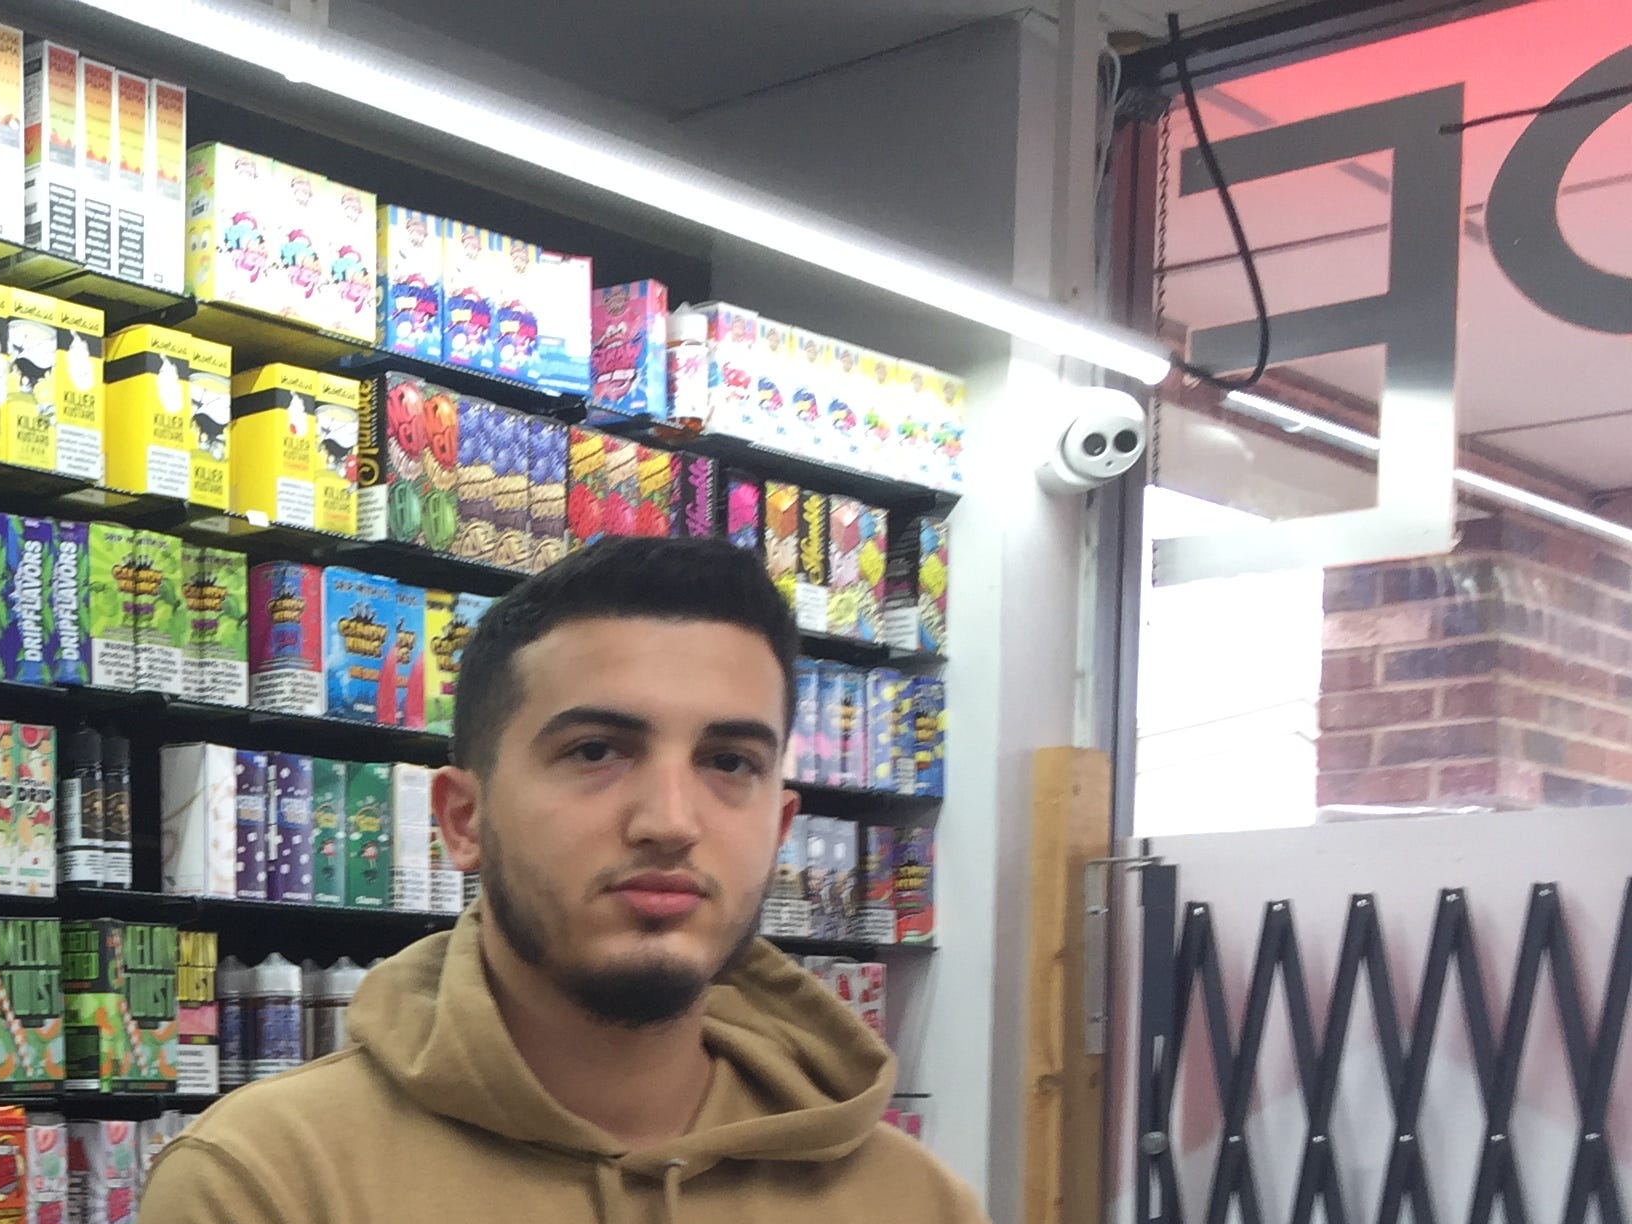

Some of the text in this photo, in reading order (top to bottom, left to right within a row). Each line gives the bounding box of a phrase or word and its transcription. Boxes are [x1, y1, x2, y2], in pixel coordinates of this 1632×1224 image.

[25, 540, 43, 661] DRIPFLAVORS
[62, 541, 80, 661] DRIPFLAVORS
[17, 786, 54, 801] DRIP
